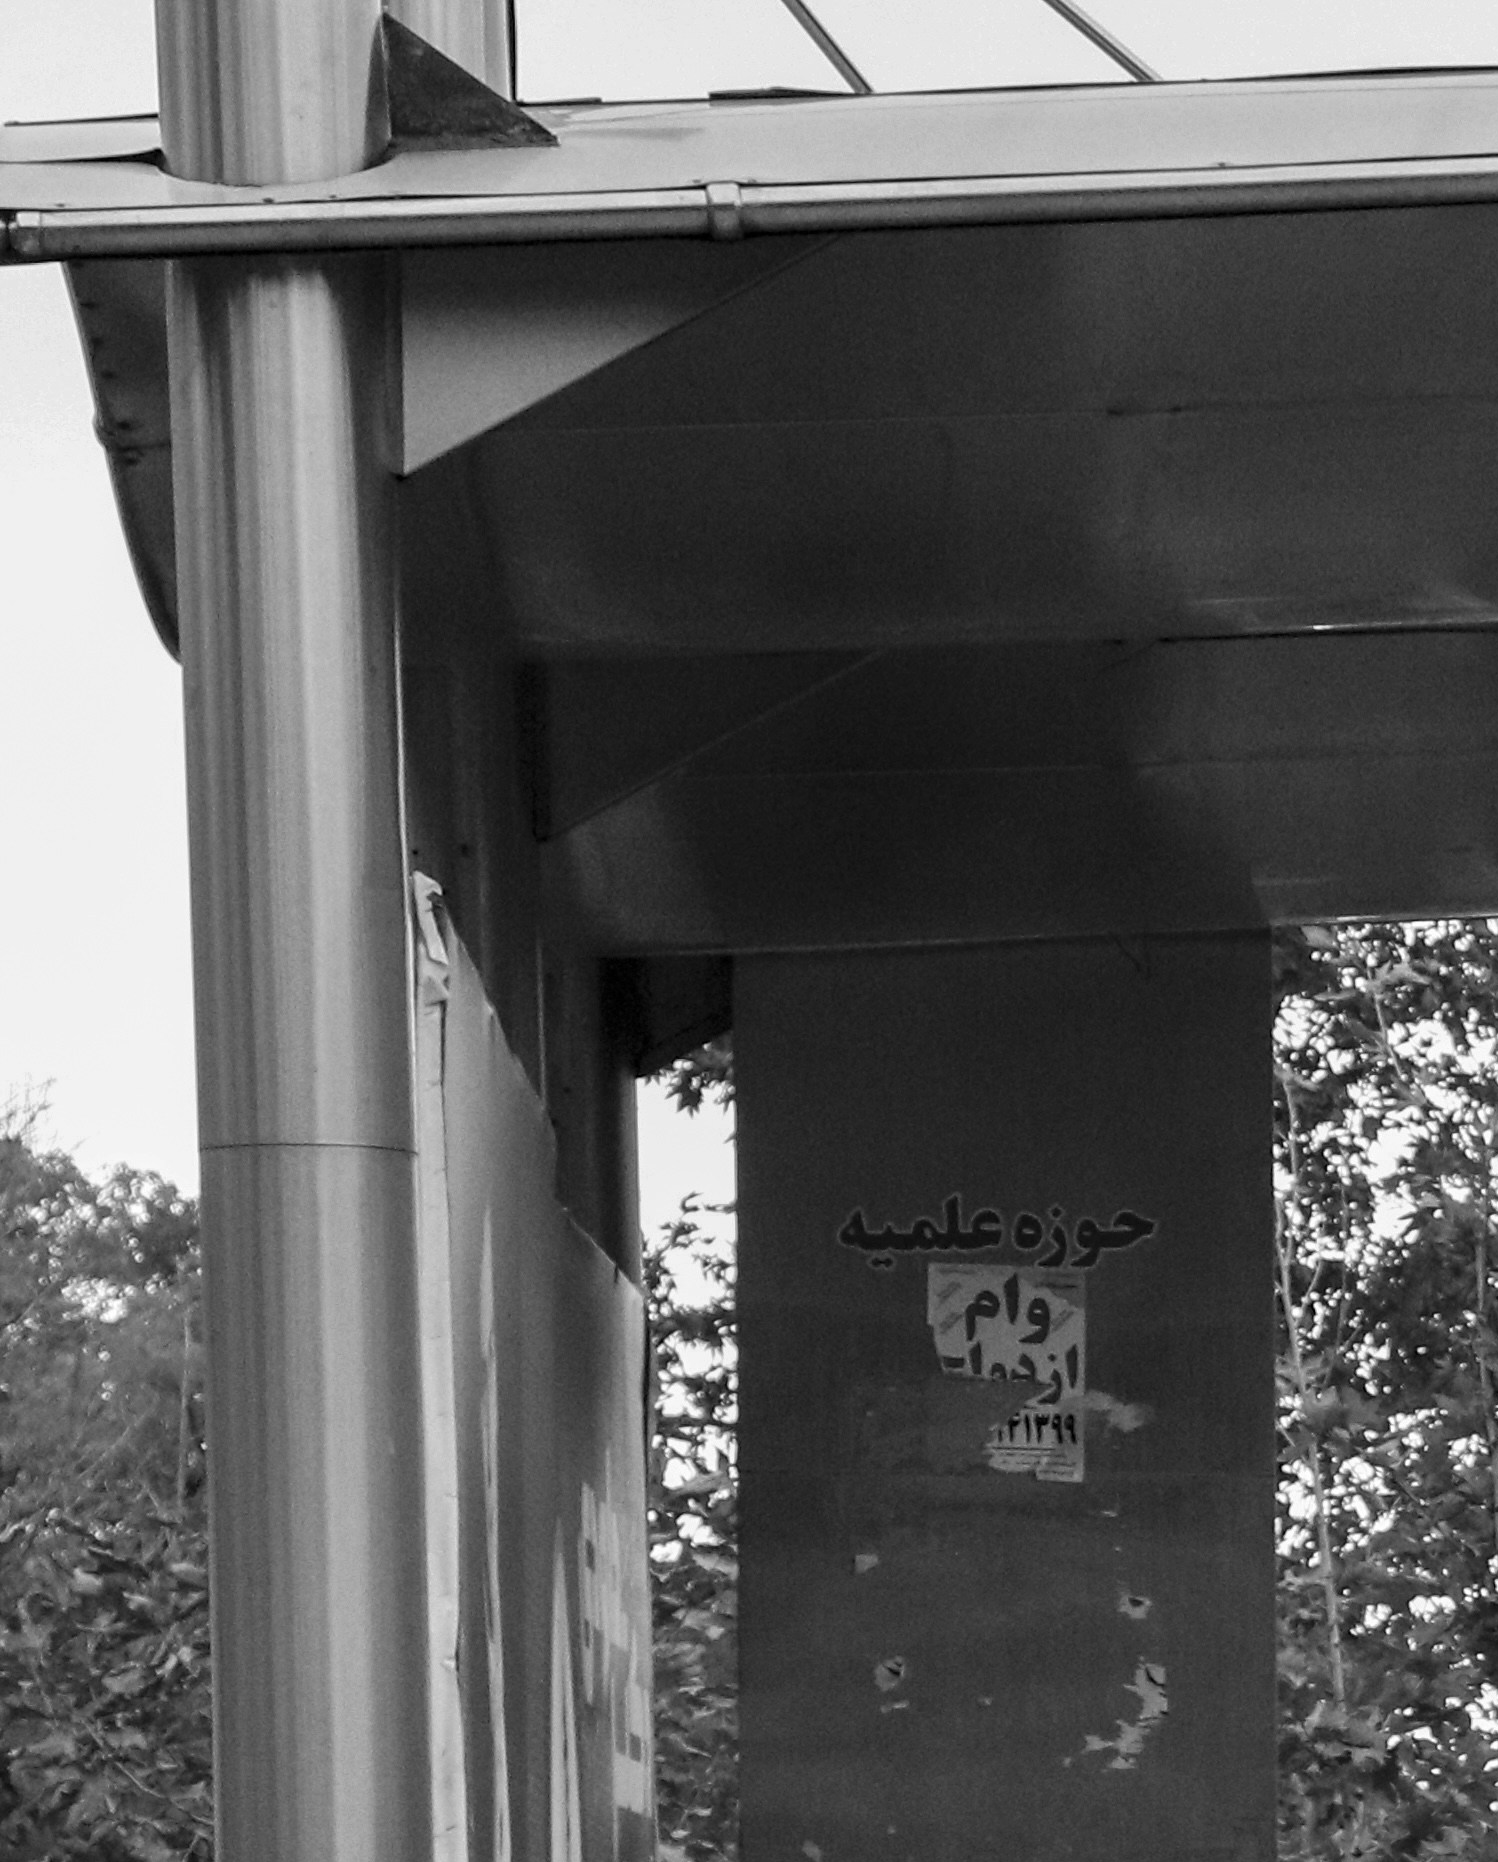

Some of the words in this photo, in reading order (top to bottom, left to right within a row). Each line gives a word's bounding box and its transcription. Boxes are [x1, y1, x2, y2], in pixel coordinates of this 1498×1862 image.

[838, 1192, 1003, 1268] علمیه
[1012, 1203, 1156, 1268] حوزه
[966, 1272, 1050, 1344] وام
